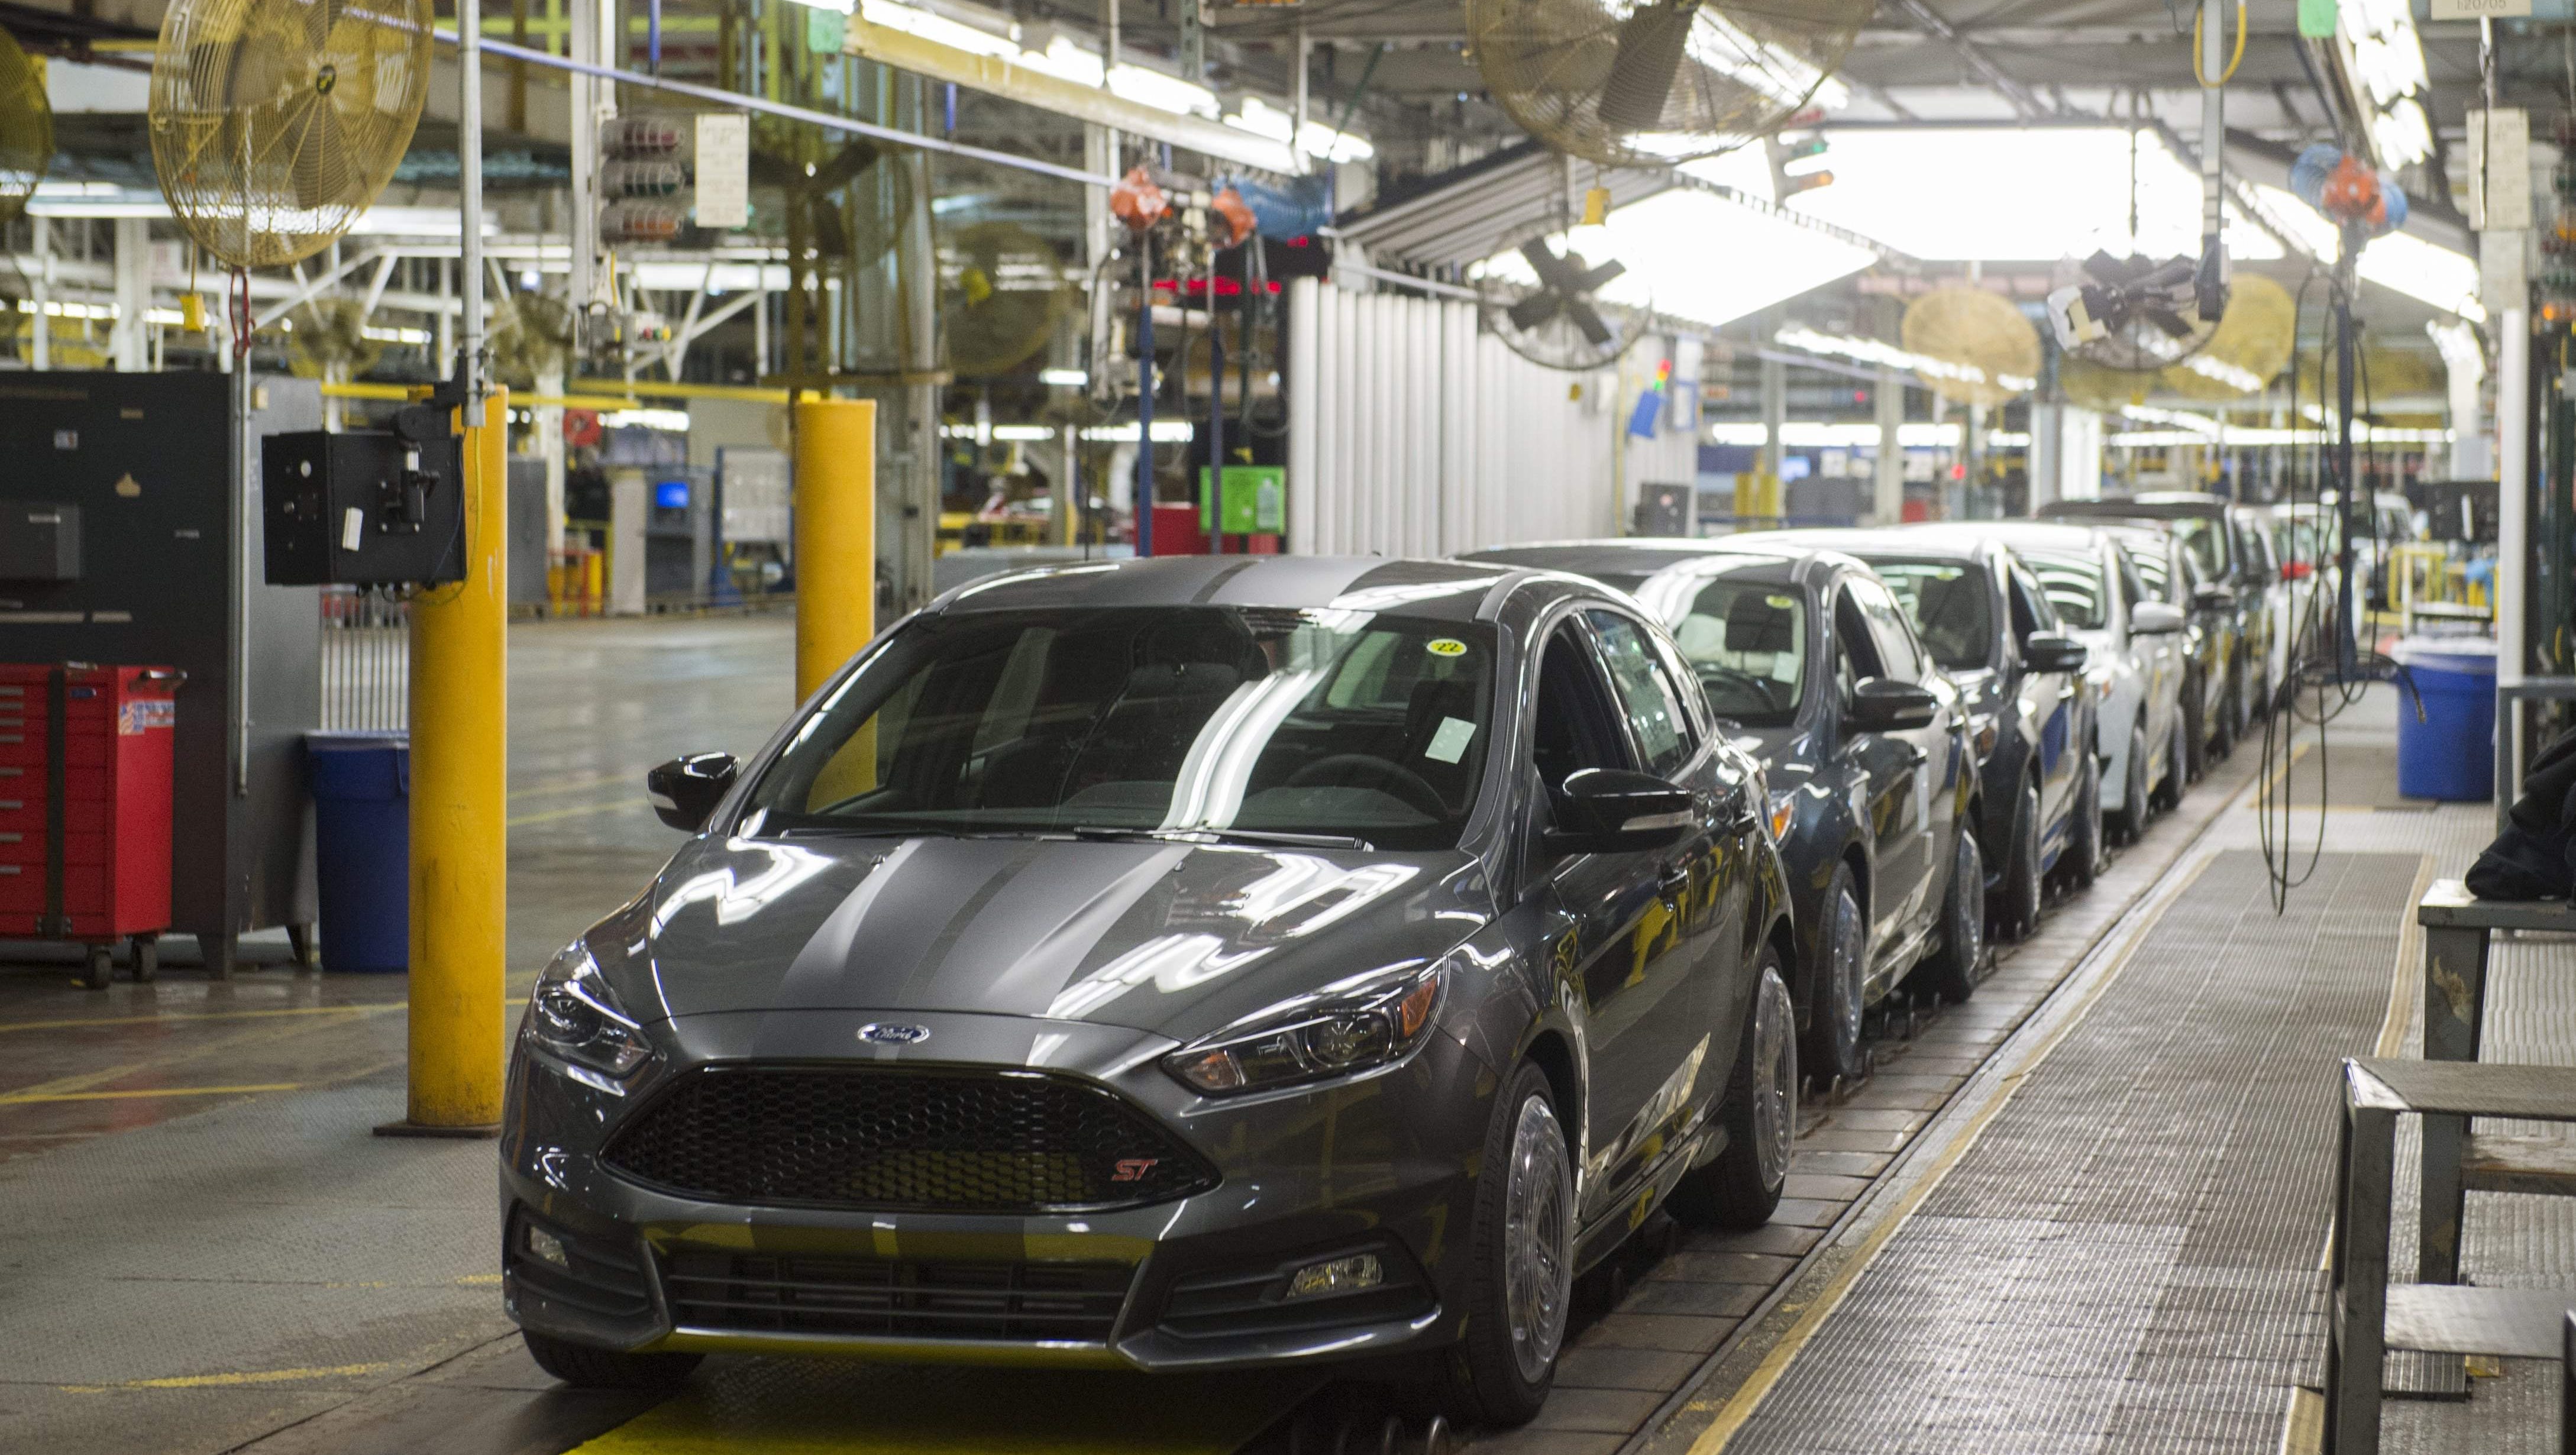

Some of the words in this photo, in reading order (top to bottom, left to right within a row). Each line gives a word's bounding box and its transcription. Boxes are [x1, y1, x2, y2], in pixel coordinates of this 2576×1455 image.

[1436, 642, 1460, 652] 22
[874, 1027, 914, 1040] Ford
[1111, 1159, 1158, 1181] ST
